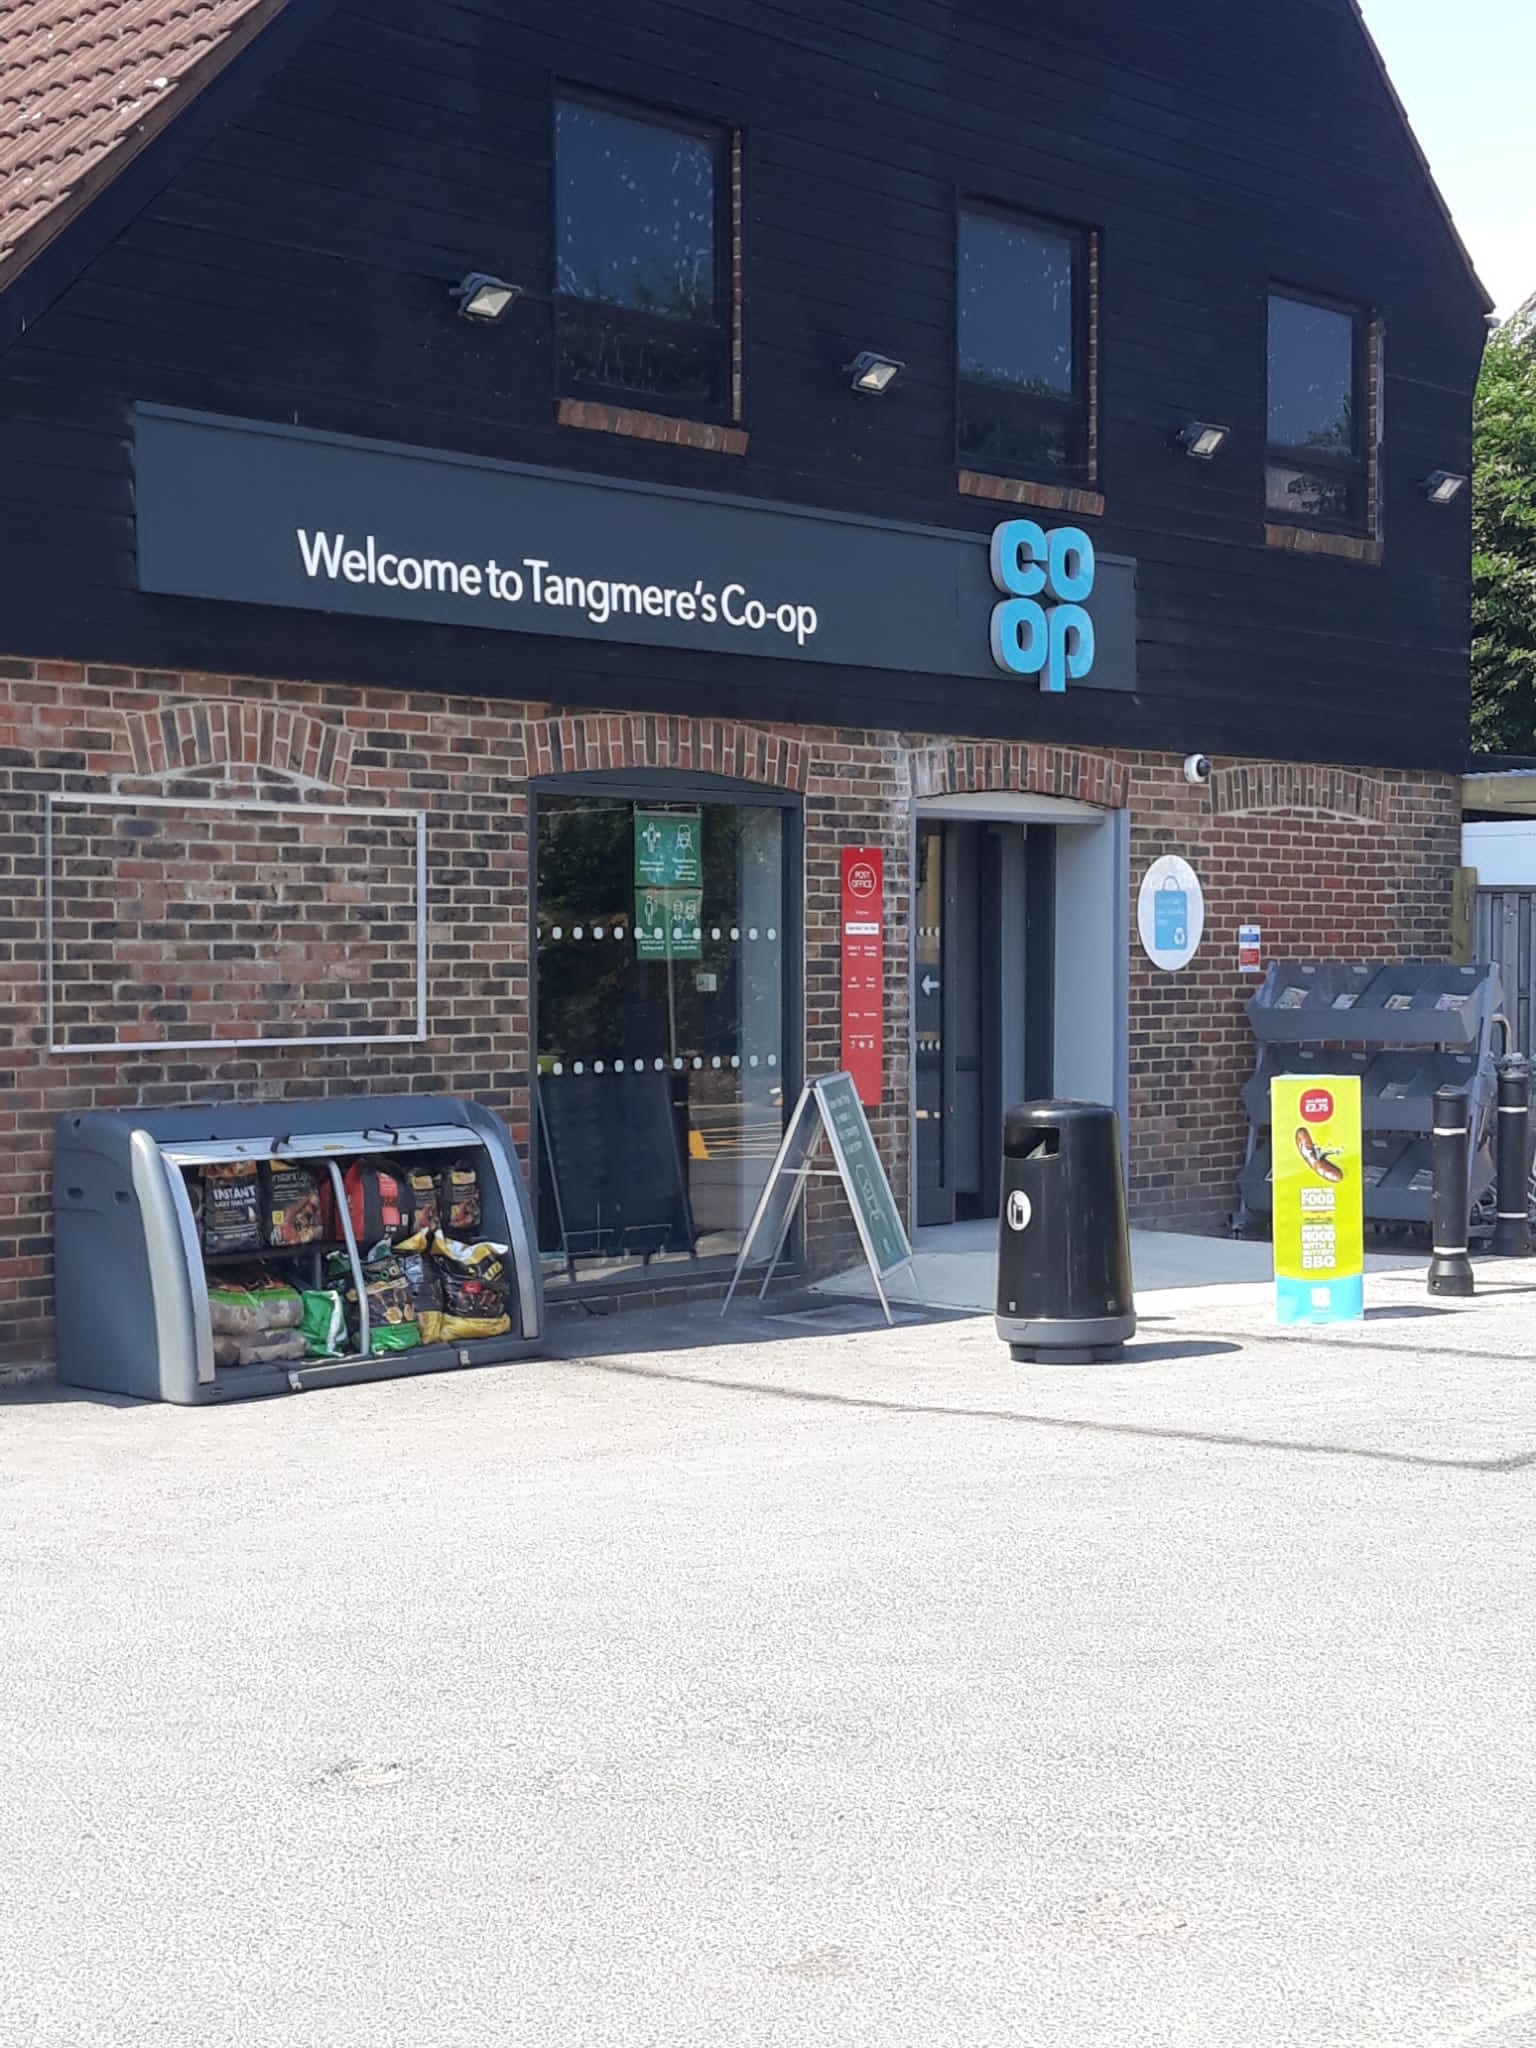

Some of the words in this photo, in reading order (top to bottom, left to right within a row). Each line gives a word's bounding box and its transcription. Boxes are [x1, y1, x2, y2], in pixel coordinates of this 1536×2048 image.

[297, 529, 483, 596] Welcome
[484, 559, 523, 602] to
[522, 558, 718, 623] Tangmere's
[720, 583, 818, 646] Co-op
[854, 870, 871, 879] POST
[851, 879, 873, 889] OFFICE
[213, 1184, 257, 1201] INSTANT
[1301, 1193, 1335, 1206] FOOD
[1302, 1255, 1336, 1269] BBQ
